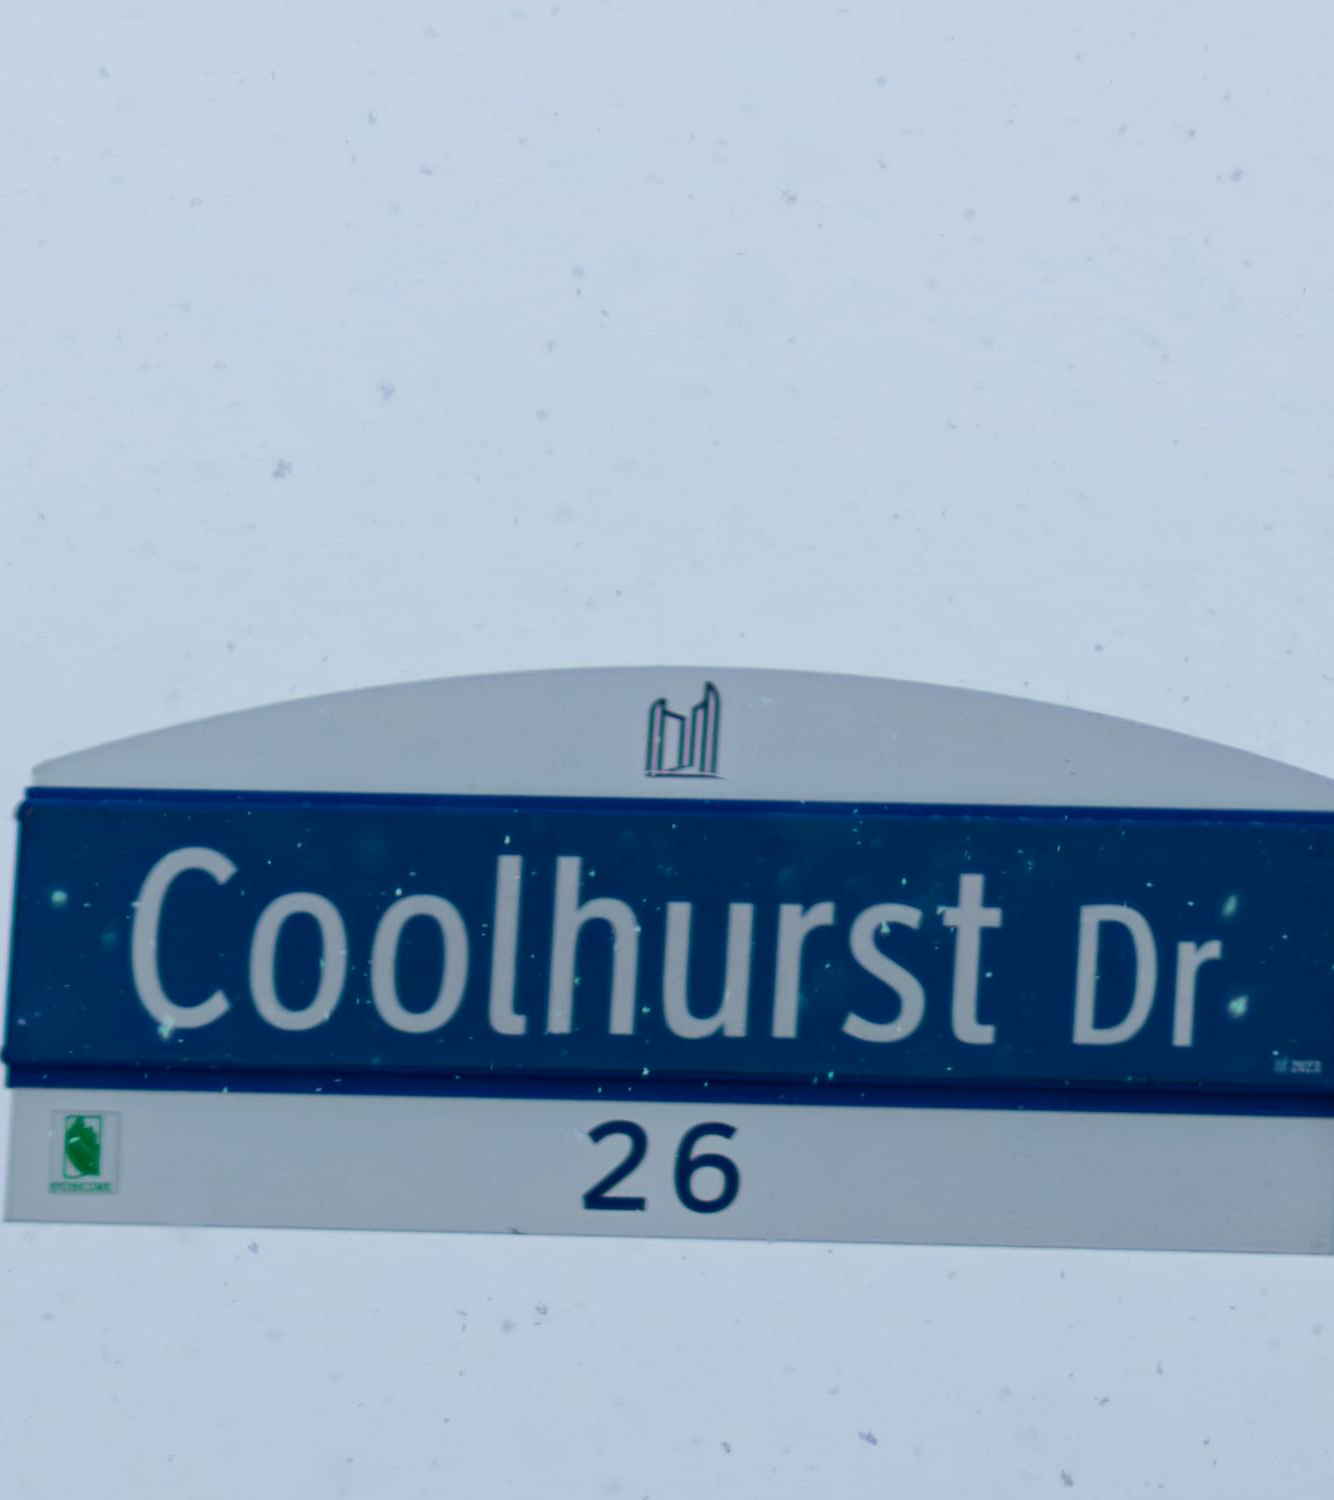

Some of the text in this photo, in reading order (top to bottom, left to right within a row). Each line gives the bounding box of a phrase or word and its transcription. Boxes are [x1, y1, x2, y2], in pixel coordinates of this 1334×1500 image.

[130, 846, 1223, 1048] Coolhurst Dr
[581, 1118, 742, 1216] 26
